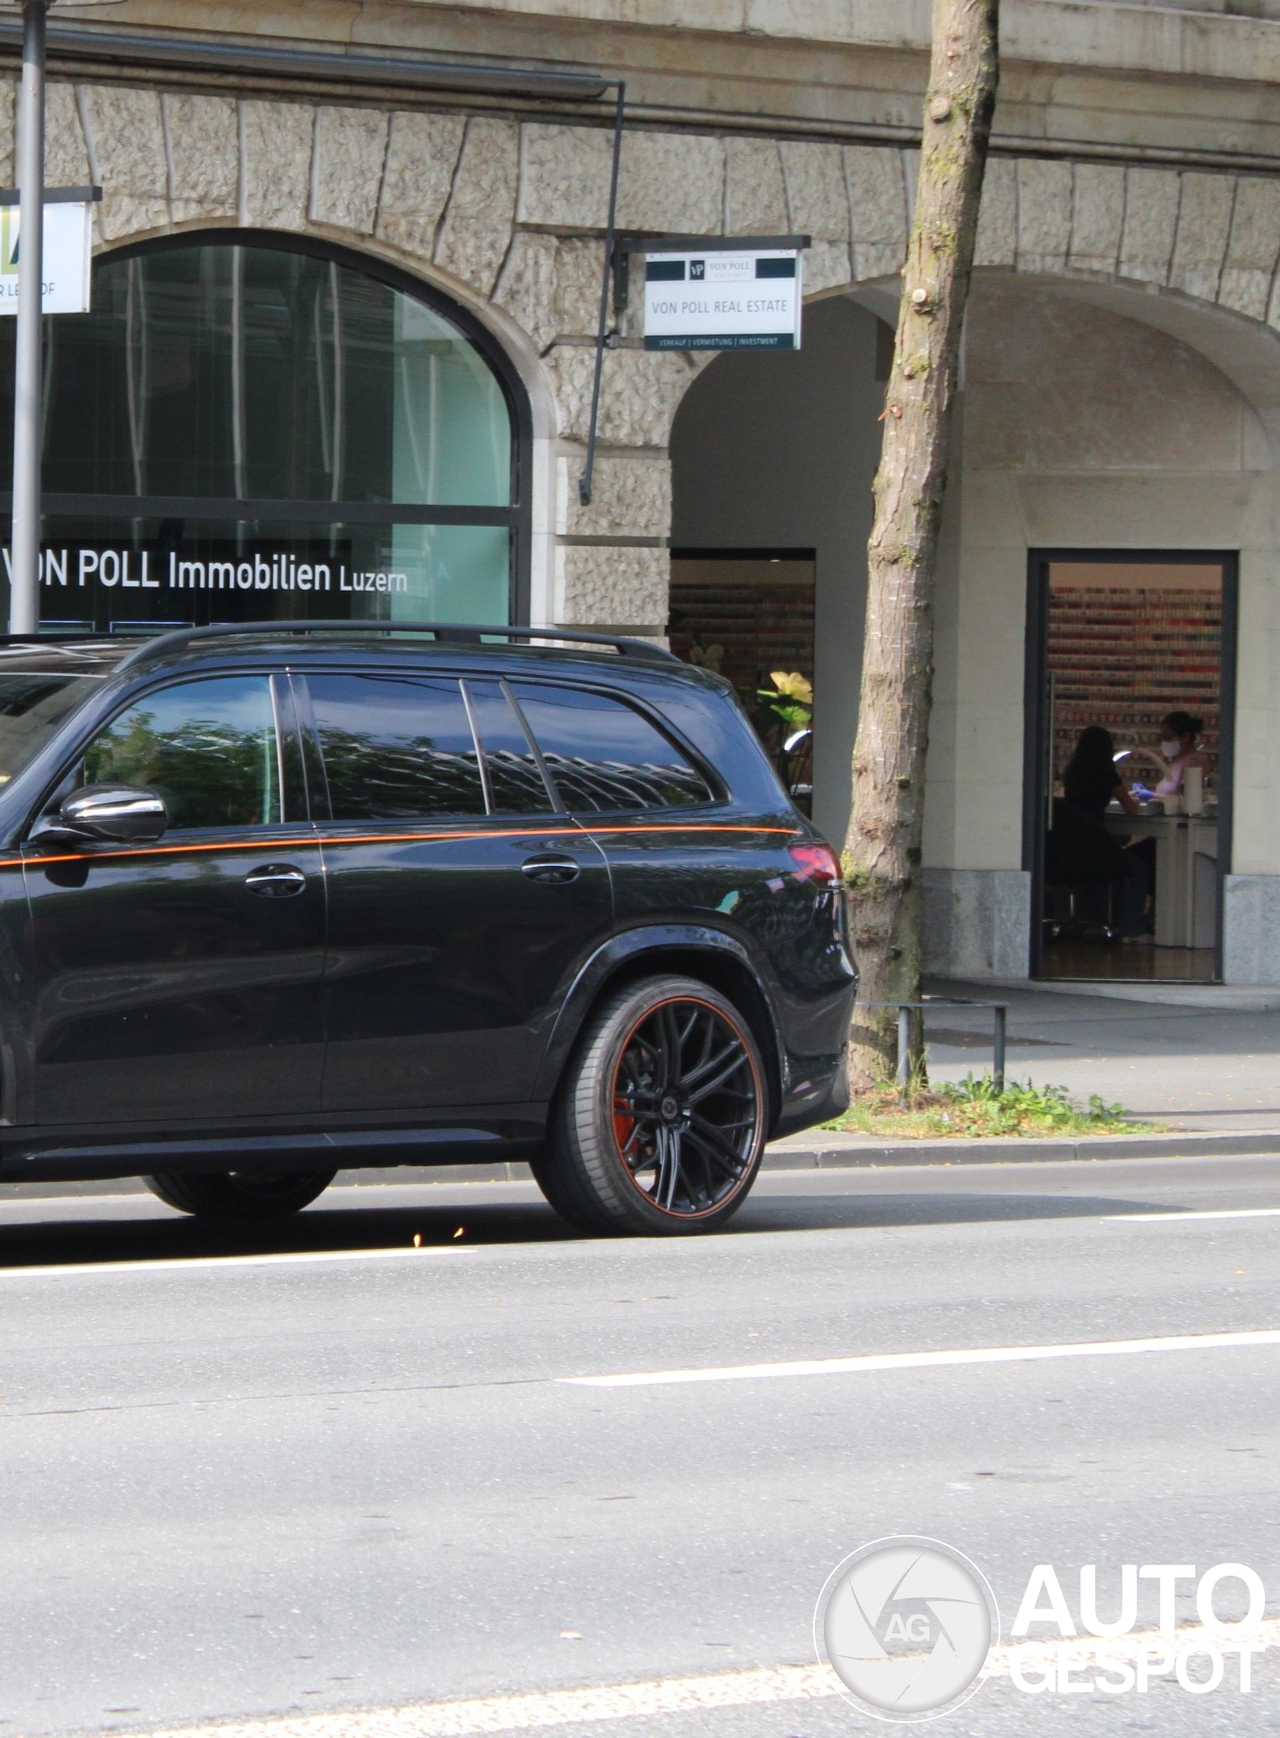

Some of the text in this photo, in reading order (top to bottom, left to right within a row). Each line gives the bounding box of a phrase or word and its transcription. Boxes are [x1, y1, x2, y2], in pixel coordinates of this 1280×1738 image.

[8, 282, 55, 297] LEOF
[652, 299, 788, 314] VON POLL REAL ESTATE
[738, 338, 778, 346] INVESTMENT
[2, 547, 408, 592] VN POLL Immobilien Luzern
